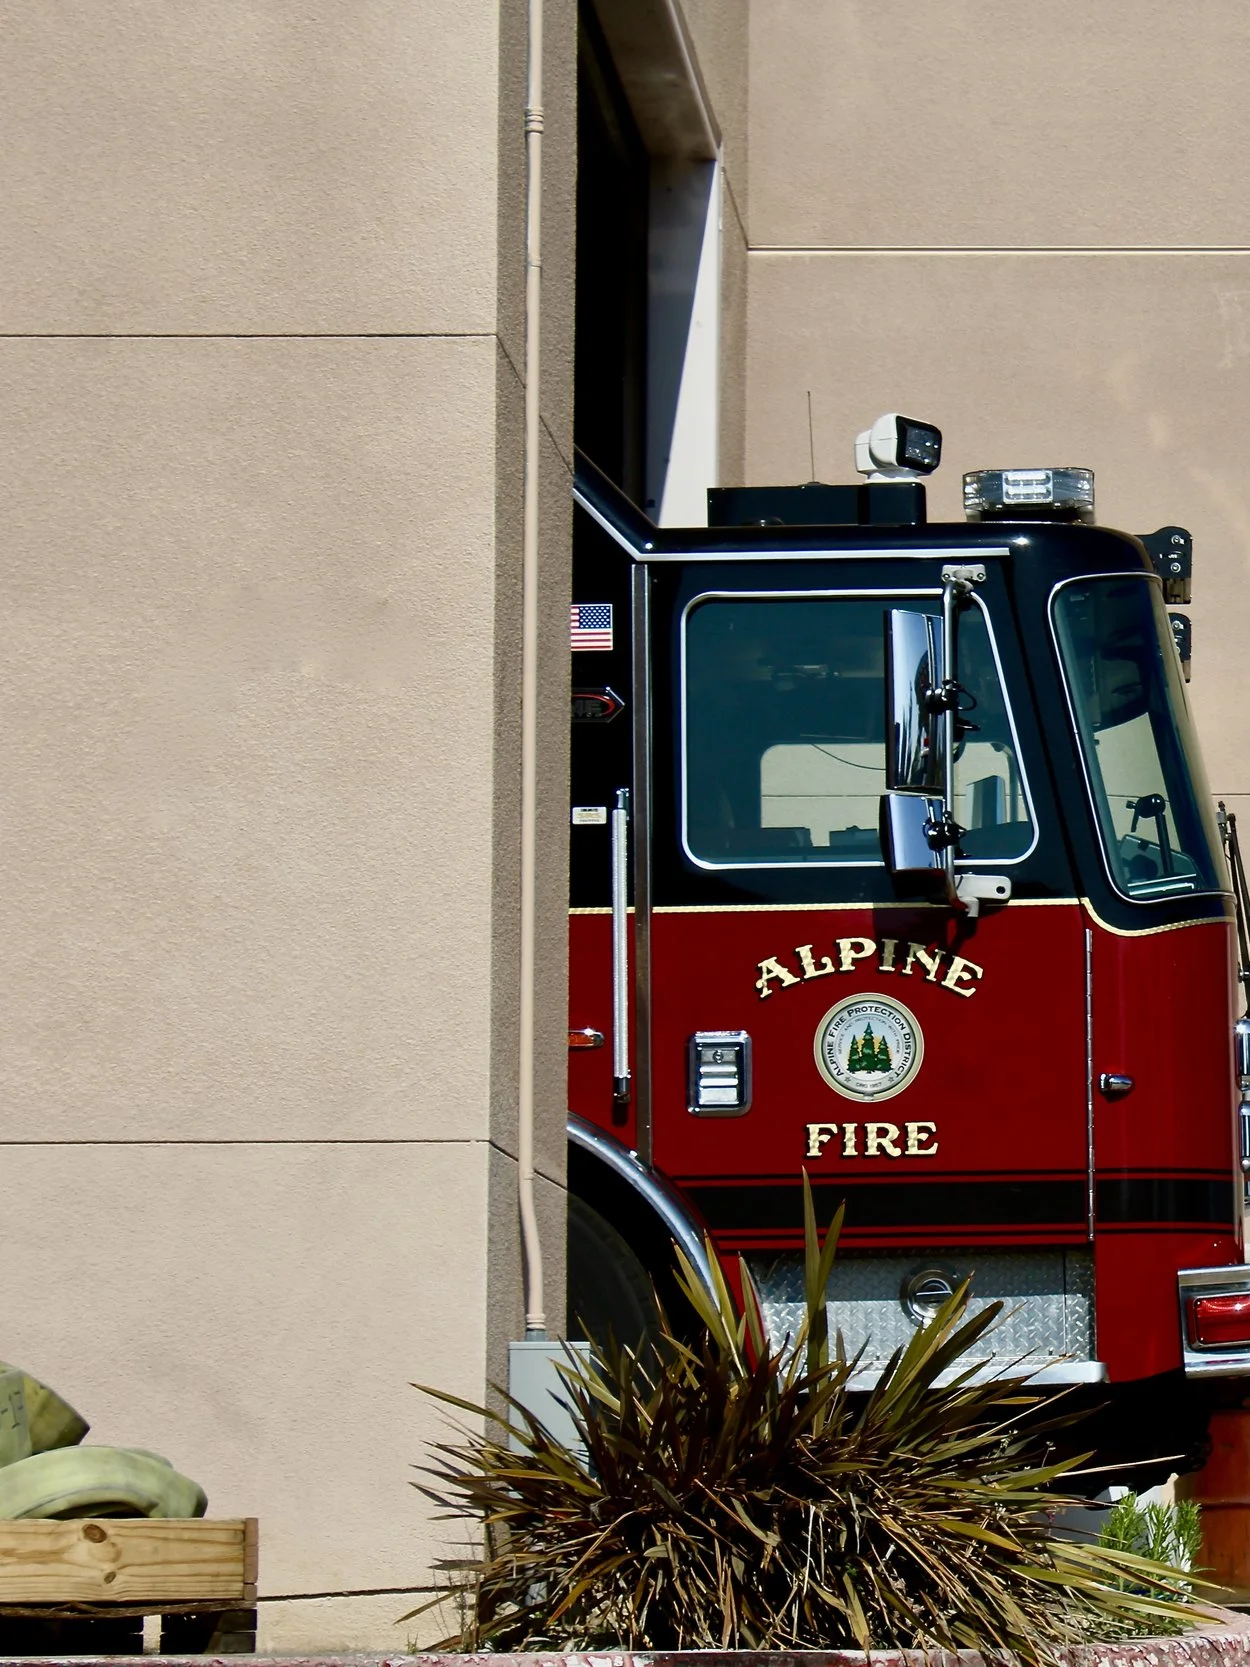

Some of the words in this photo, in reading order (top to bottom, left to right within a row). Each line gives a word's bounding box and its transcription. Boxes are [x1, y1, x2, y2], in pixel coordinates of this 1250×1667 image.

[755, 937, 984, 998] ALPINE
[828, 1015, 846, 1038] FIRE
[847, 1006, 906, 1031] PROTECTION
[826, 1041, 845, 1078] ALPINE
[893, 1032, 912, 1078] DISTRICT
[806, 1121, 939, 1157] FIRE
